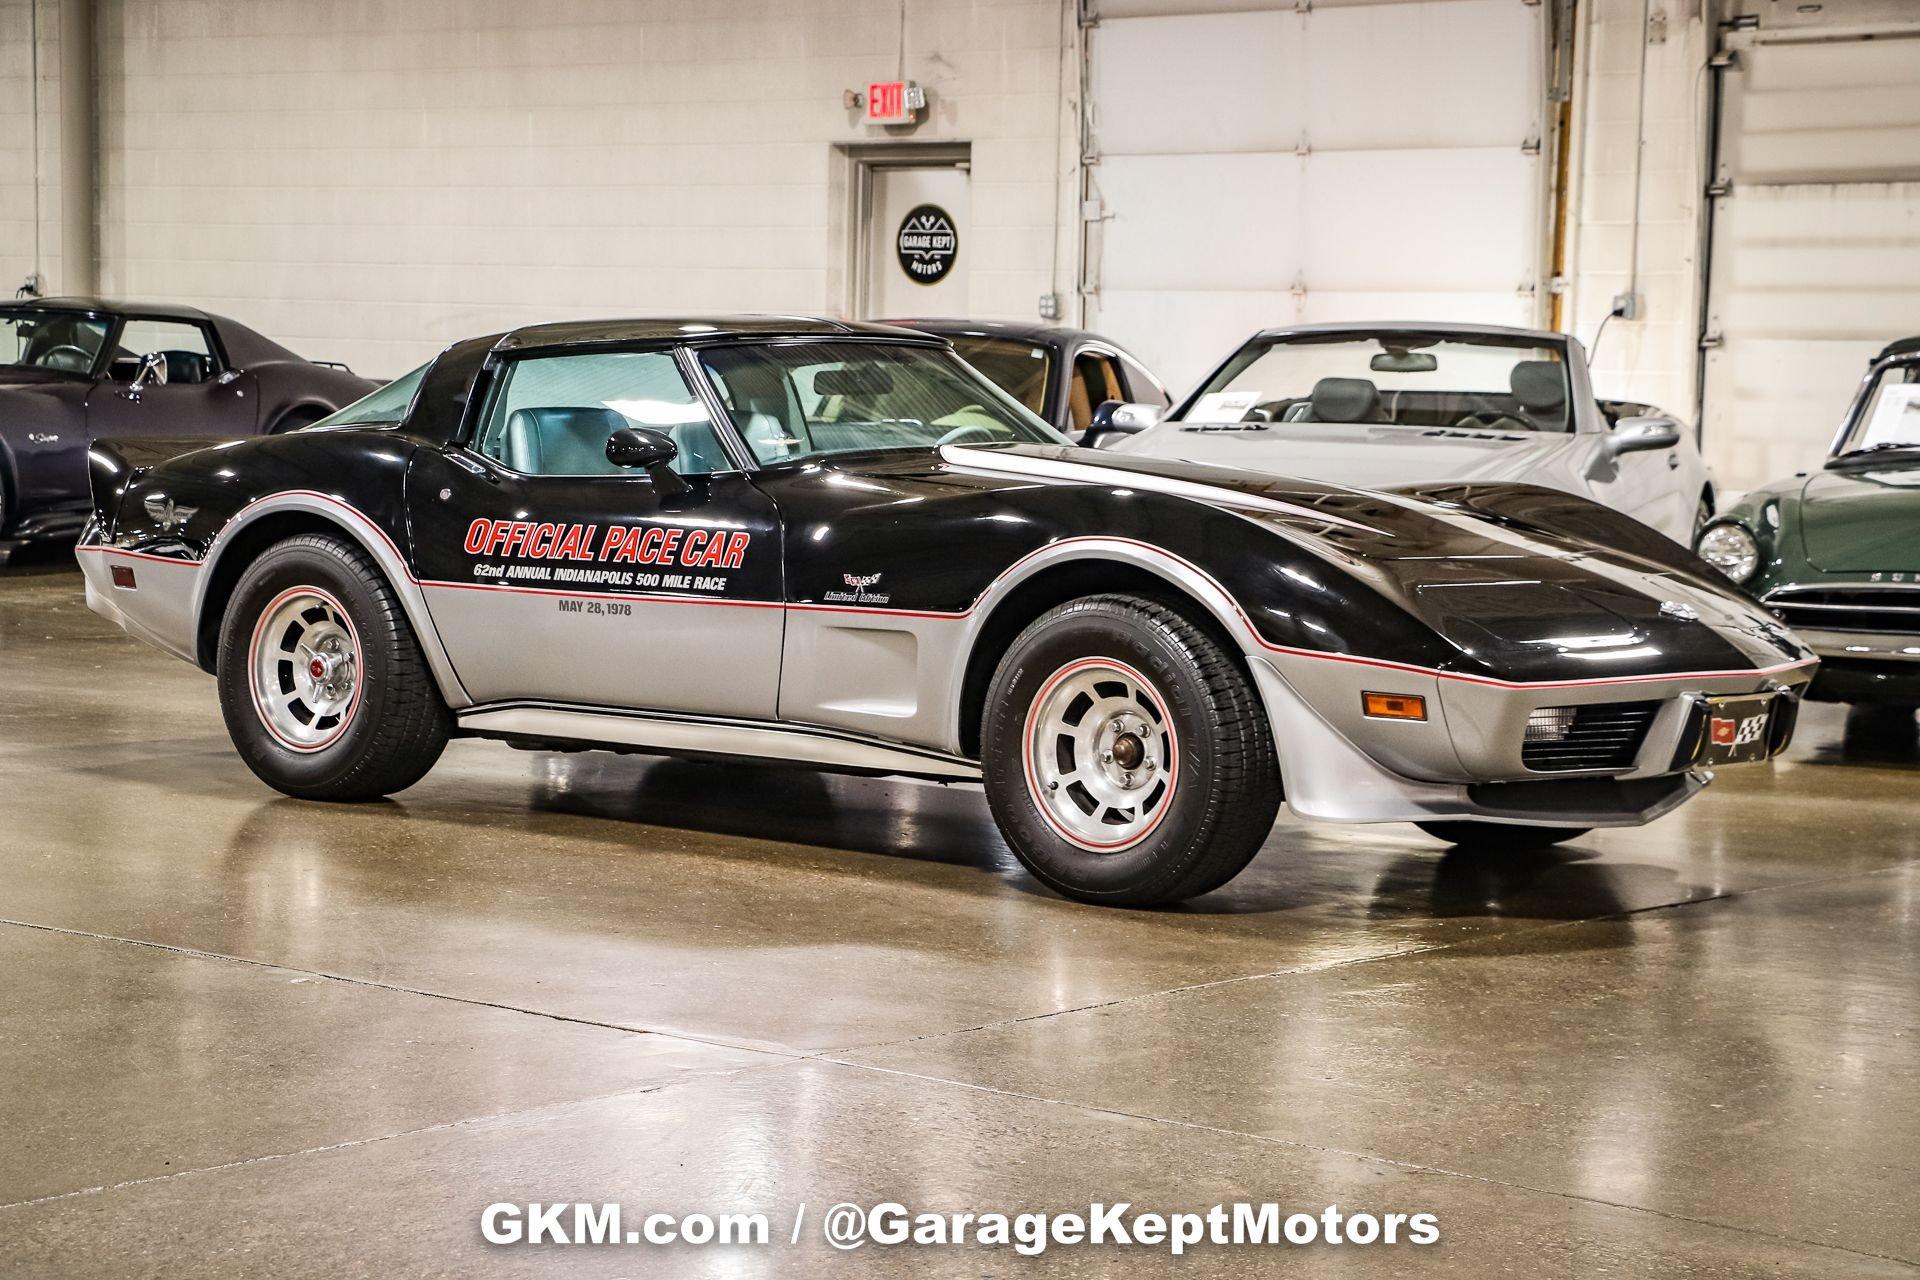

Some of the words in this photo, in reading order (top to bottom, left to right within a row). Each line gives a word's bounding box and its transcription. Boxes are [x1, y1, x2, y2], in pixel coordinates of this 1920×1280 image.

[870, 85, 904, 117] EXIT
[903, 235, 931, 248] GARAGE
[932, 235, 950, 248] KEPT
[911, 260, 942, 275] MOTORS
[464, 518, 597, 561] OFFICIAL
[598, 526, 682, 566] PACE
[680, 530, 751, 568] CAR
[473, 564, 505, 577] 62nd
[506, 565, 552, 580] ANNUAL
[553, 568, 634, 586] INDIANAPOLIS
[635, 573, 660, 587] 500
[662, 574, 692, 589] MILE
[693, 577, 727, 591] RACE
[823, 591, 859, 602] Limited
[558, 599, 583, 612] MAY
